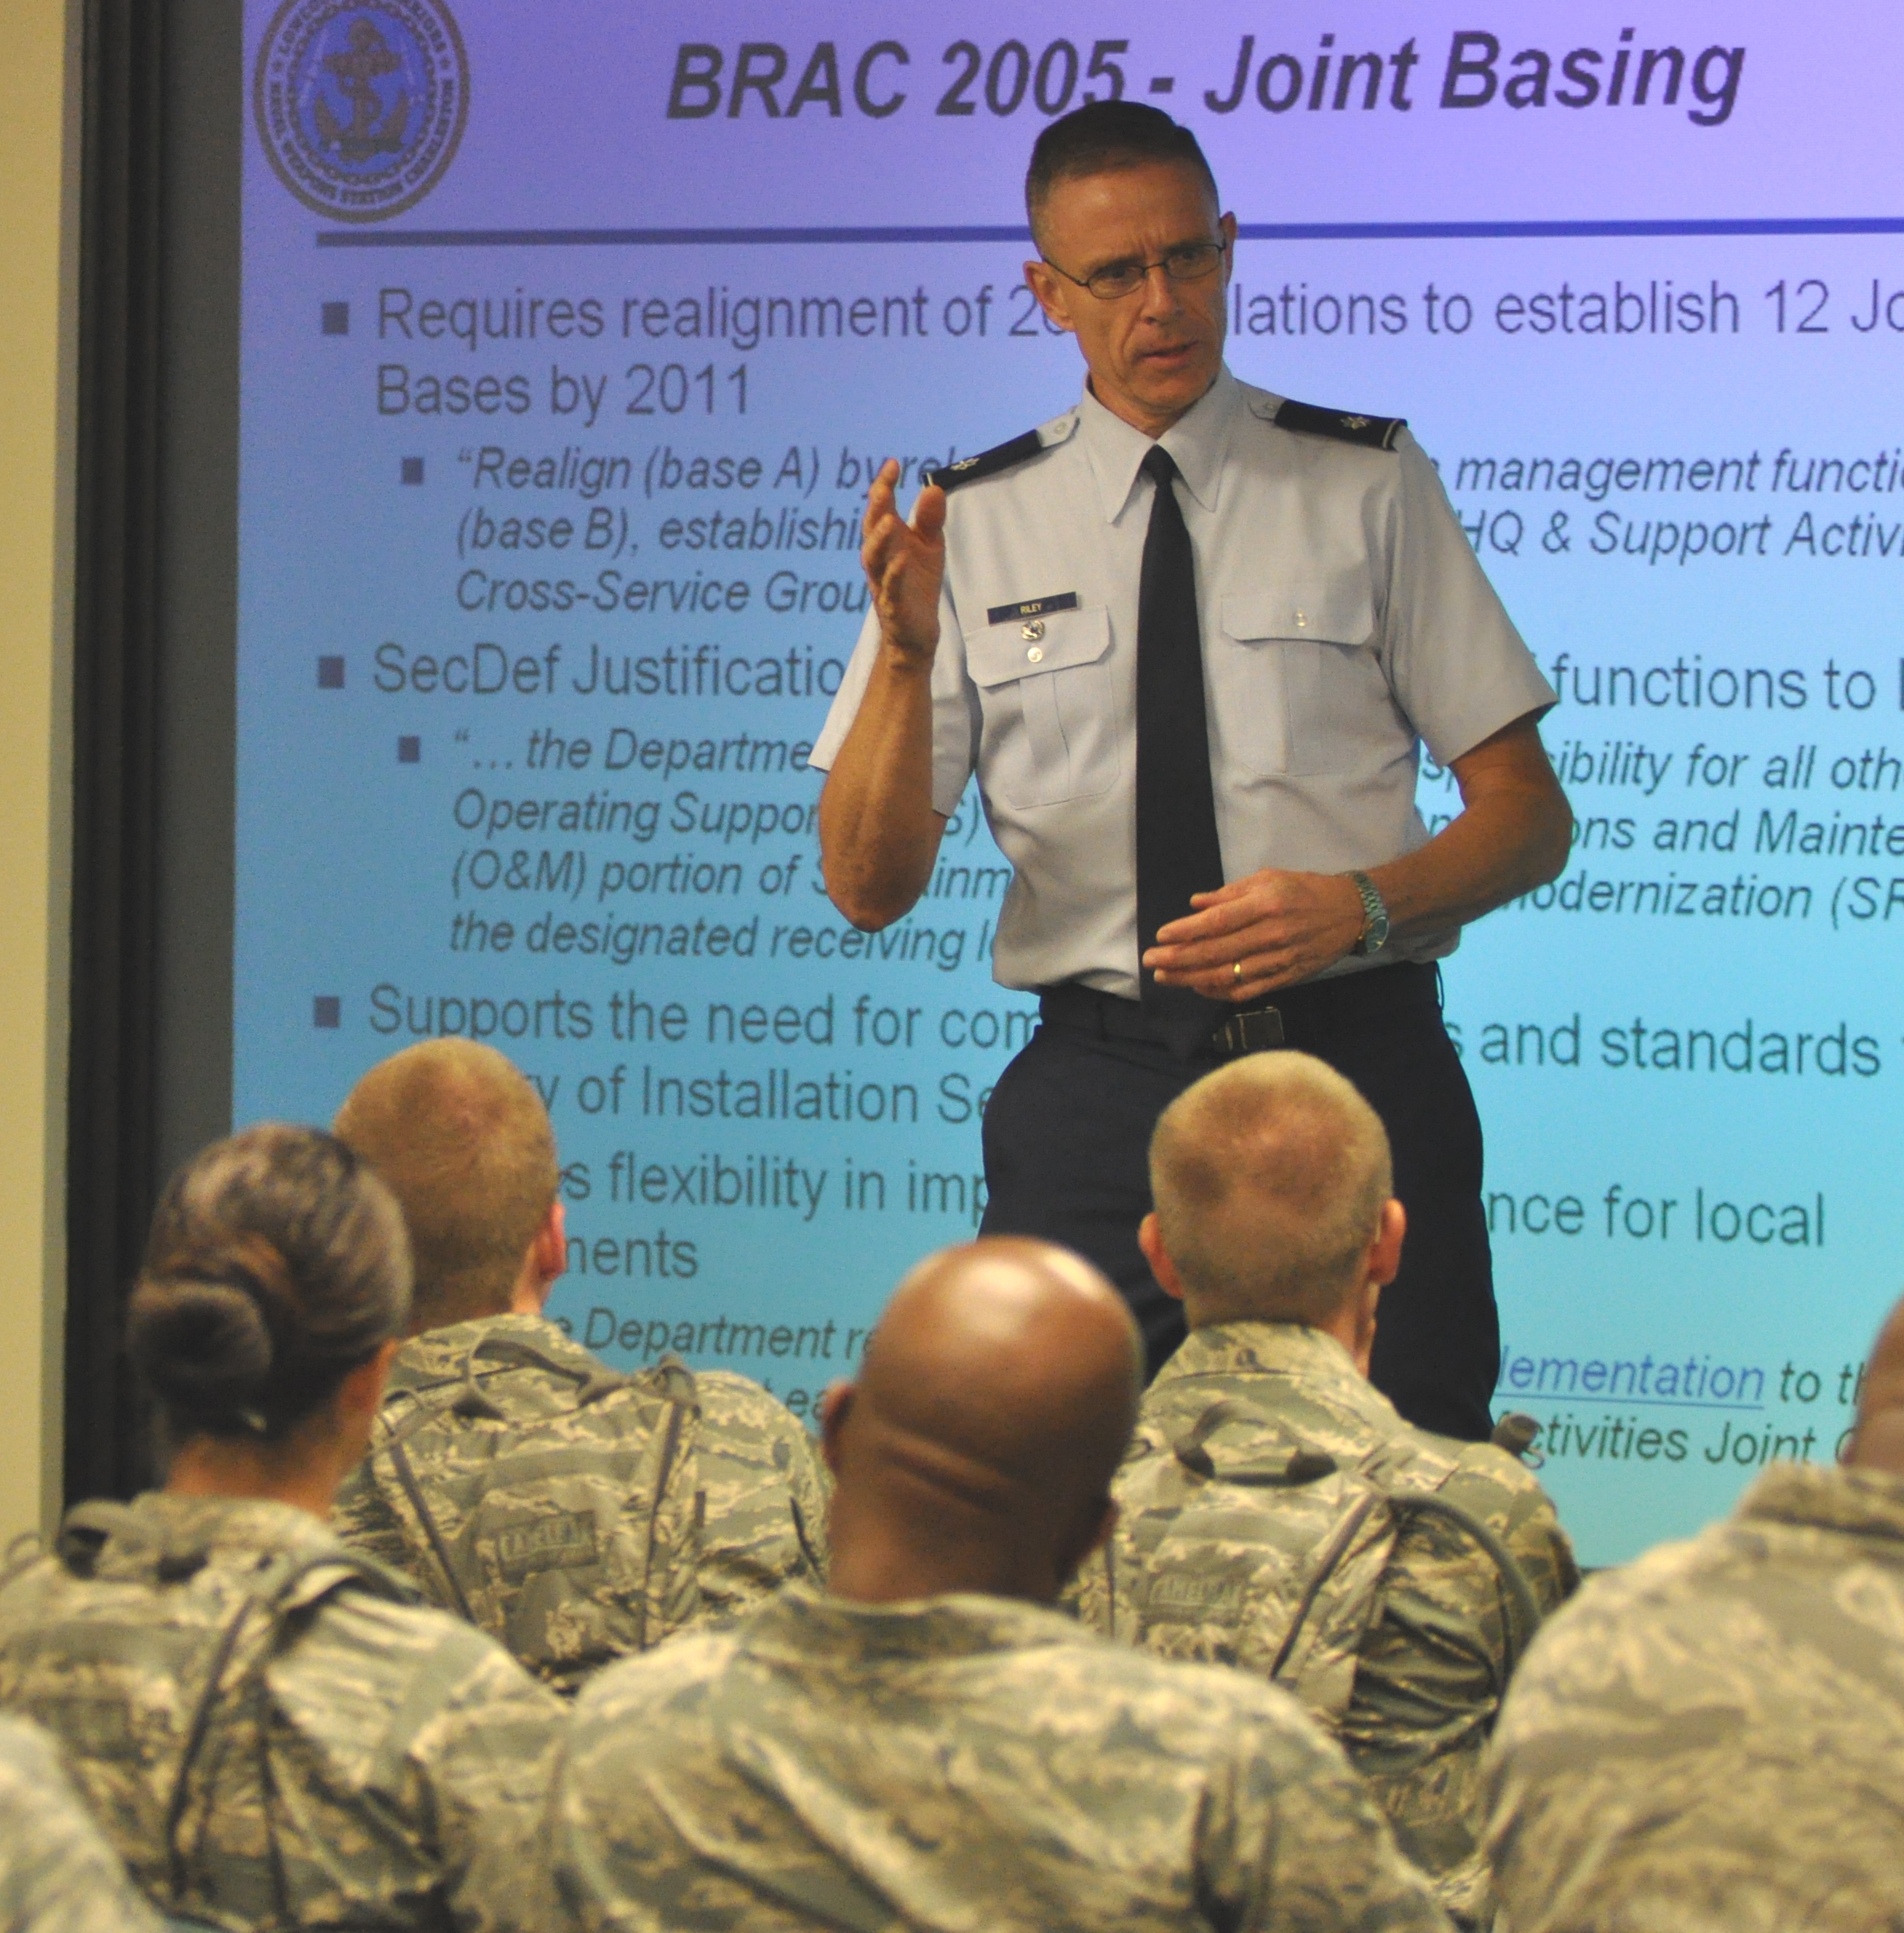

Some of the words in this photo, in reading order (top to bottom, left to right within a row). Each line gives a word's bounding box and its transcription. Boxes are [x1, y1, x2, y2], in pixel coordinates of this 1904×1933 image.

[665, 40, 910, 120] BRAC
[936, 39, 1130, 118] 2005
[1148, 76, 1175, 94] -
[1203, 33, 1419, 115] Joint
[1439, 27, 1746, 127] Basing
[377, 287, 605, 352] Requires
[621, 284, 929, 352] realignment
[942, 284, 994, 337] of
[1422, 282, 1473, 335] to
[1494, 279, 1740, 335] establish
[1764, 279, 1830, 333] 12
[376, 363, 531, 416] Bases
[550, 364, 608, 429] by
[625, 362, 746, 415] 2011
[643, 445, 763, 499] (base
[773, 445, 820, 498] A)
[1454, 450, 1761, 503] management
[1771, 447, 1904, 493] functi
[456, 506, 575, 559] (base
[583, 506, 638, 559] B),
[658, 506, 864, 554] establishi
[1457, 509, 1525, 557] HQ
[1541, 509, 1570, 554] &
[1589, 509, 1773, 566] Support
[455, 567, 750, 613] Cross-Service
[763, 569, 869, 615] Grou
[373, 641, 562, 695] SecDef
[570, 641, 844, 698] Justificatio
[1549, 652, 1808, 712] functions
[1823, 658, 1876, 711] to
[526, 728, 592, 770] the
[603, 728, 813, 782] Departme
[1550, 741, 1673, 796] ibility
[1686, 742, 1750, 787] for
[1762, 744, 1817, 789] all
[453, 786, 660, 839] Operating
[1653, 808, 1740, 852] and
[451, 848, 586, 899] (O&M)
[597, 852, 743, 904] portion
[758, 853, 802, 896] of
[923, 856, 1012, 899] inm
[1503, 870, 1814, 920] odernization
[450, 911, 515, 953] the
[525, 913, 759, 966] designated
[768, 918, 965, 972] receiving
[368, 983, 594, 1042] Supports
[608, 989, 689, 1043] the
[707, 994, 835, 1045] need
[854, 993, 923, 1048] for
[1480, 1013, 1581, 1067] and
[1601, 1017, 1881, 1077] standards
[576, 1063, 627, 1115] of
[642, 1064, 917, 1122] Installation
[937, 1073, 992, 1124] S
[607, 1149, 827, 1222] flexibility
[845, 1157, 885, 1211] in
[1487, 1191, 1586, 1236] nce
[1603, 1183, 1678, 1240] for
[1696, 1187, 1824, 1247] local
[581, 1304, 838, 1365] Department
[1780, 1361, 1822, 1404] to
[1532, 1411, 1689, 1462] tivities
[1705, 1421, 1817, 1465] Joint
